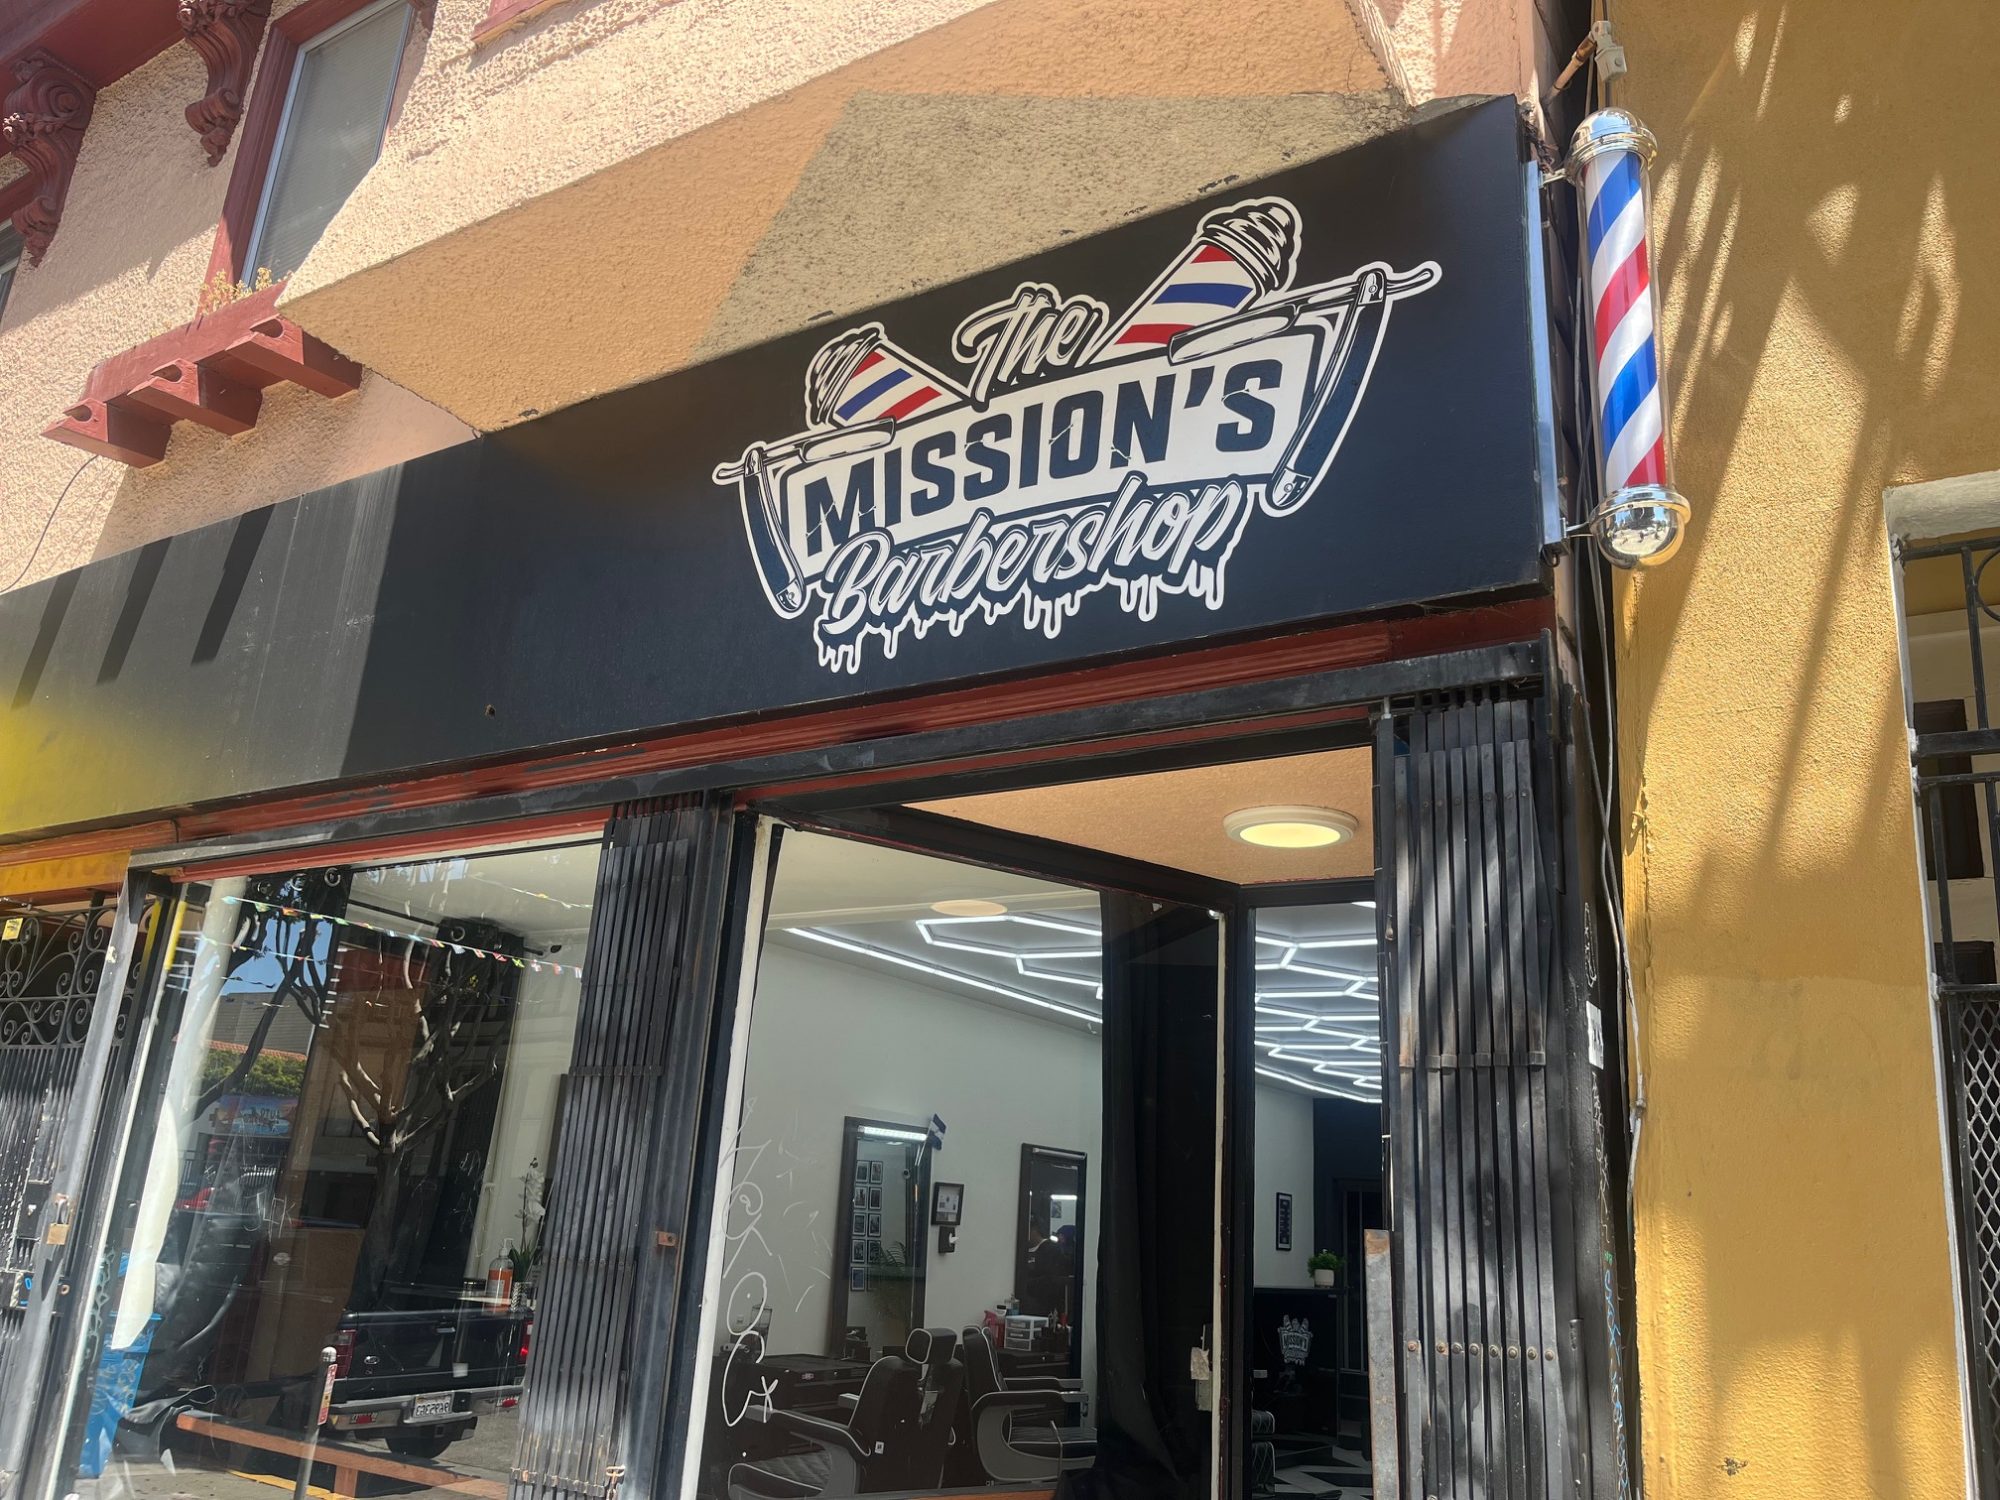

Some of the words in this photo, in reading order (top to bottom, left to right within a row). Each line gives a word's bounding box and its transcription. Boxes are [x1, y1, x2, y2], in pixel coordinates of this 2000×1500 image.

[960, 292, 1099, 403] The
[804, 358, 1283, 558] MISSION'S
[822, 474, 1242, 635] Barbershop
